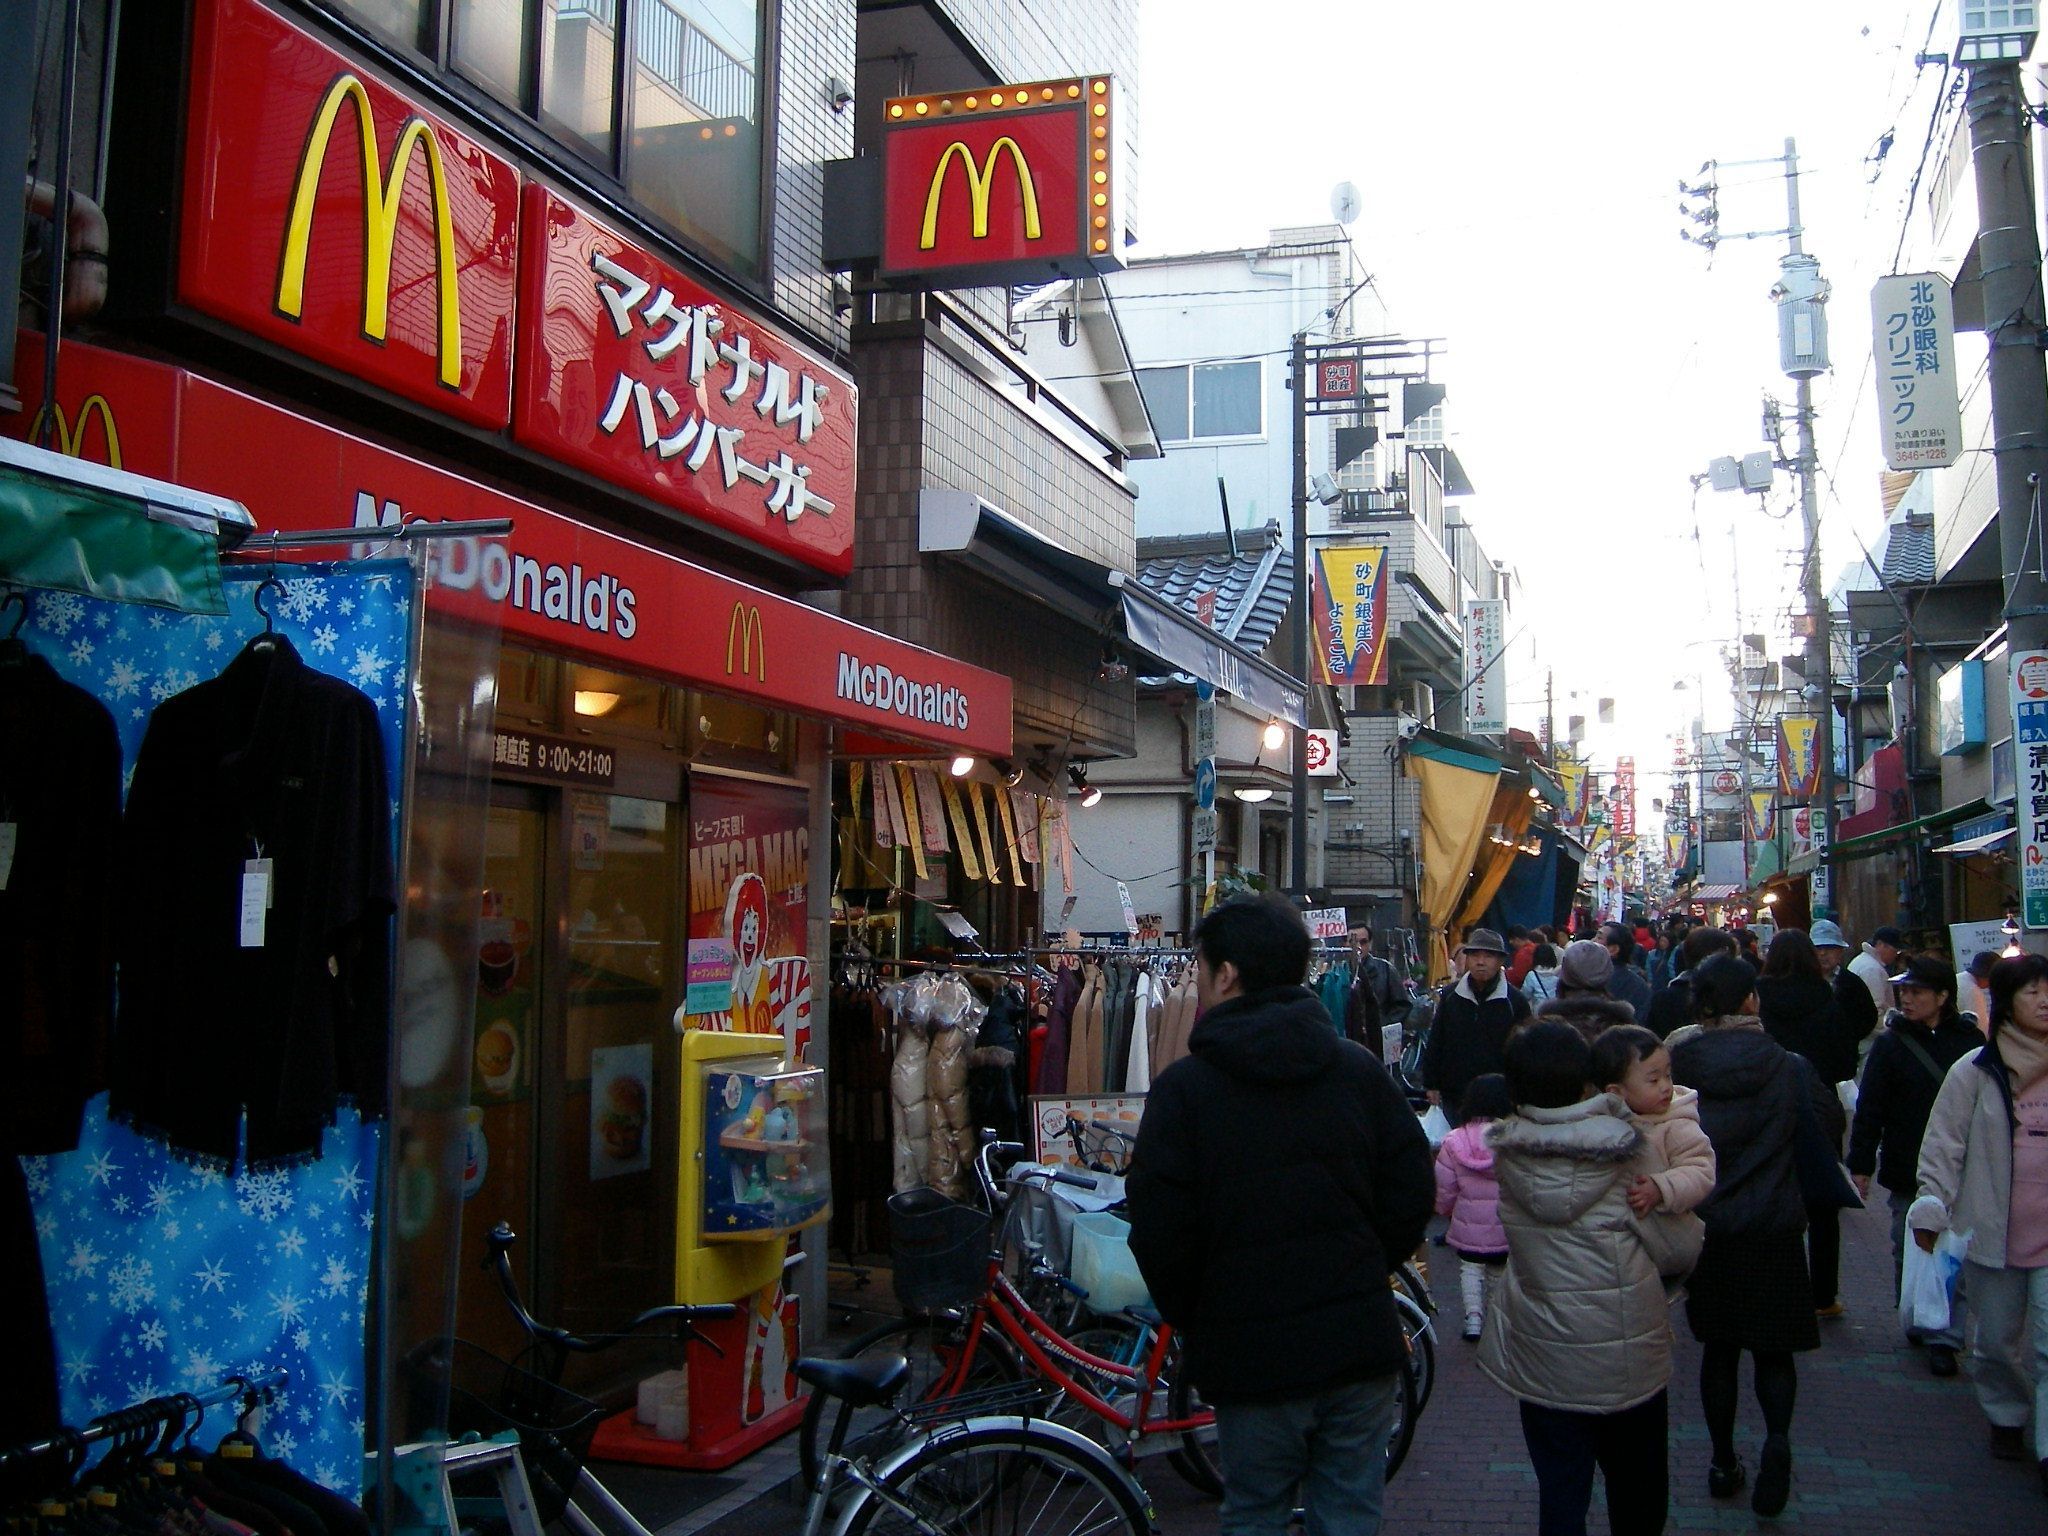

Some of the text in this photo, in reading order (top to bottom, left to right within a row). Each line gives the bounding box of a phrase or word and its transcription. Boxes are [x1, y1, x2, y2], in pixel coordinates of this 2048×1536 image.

[592, 252, 830, 444] マクドナルド
[1886, 312, 1915, 425] クリニック
[1910, 281, 1940, 375] 北砂眼科
[599, 372, 836, 522] ハンバーガー
[1896, 449, 1947, 462] 3646-1226
[1328, 602, 1346, 675] ようこそ
[1354, 561, 1374, 655] 砂町銀座へ
[838, 652, 969, 731] McDonald's
[492, 734, 530, 768] 銀座店
[763, 827, 809, 896] MAC
